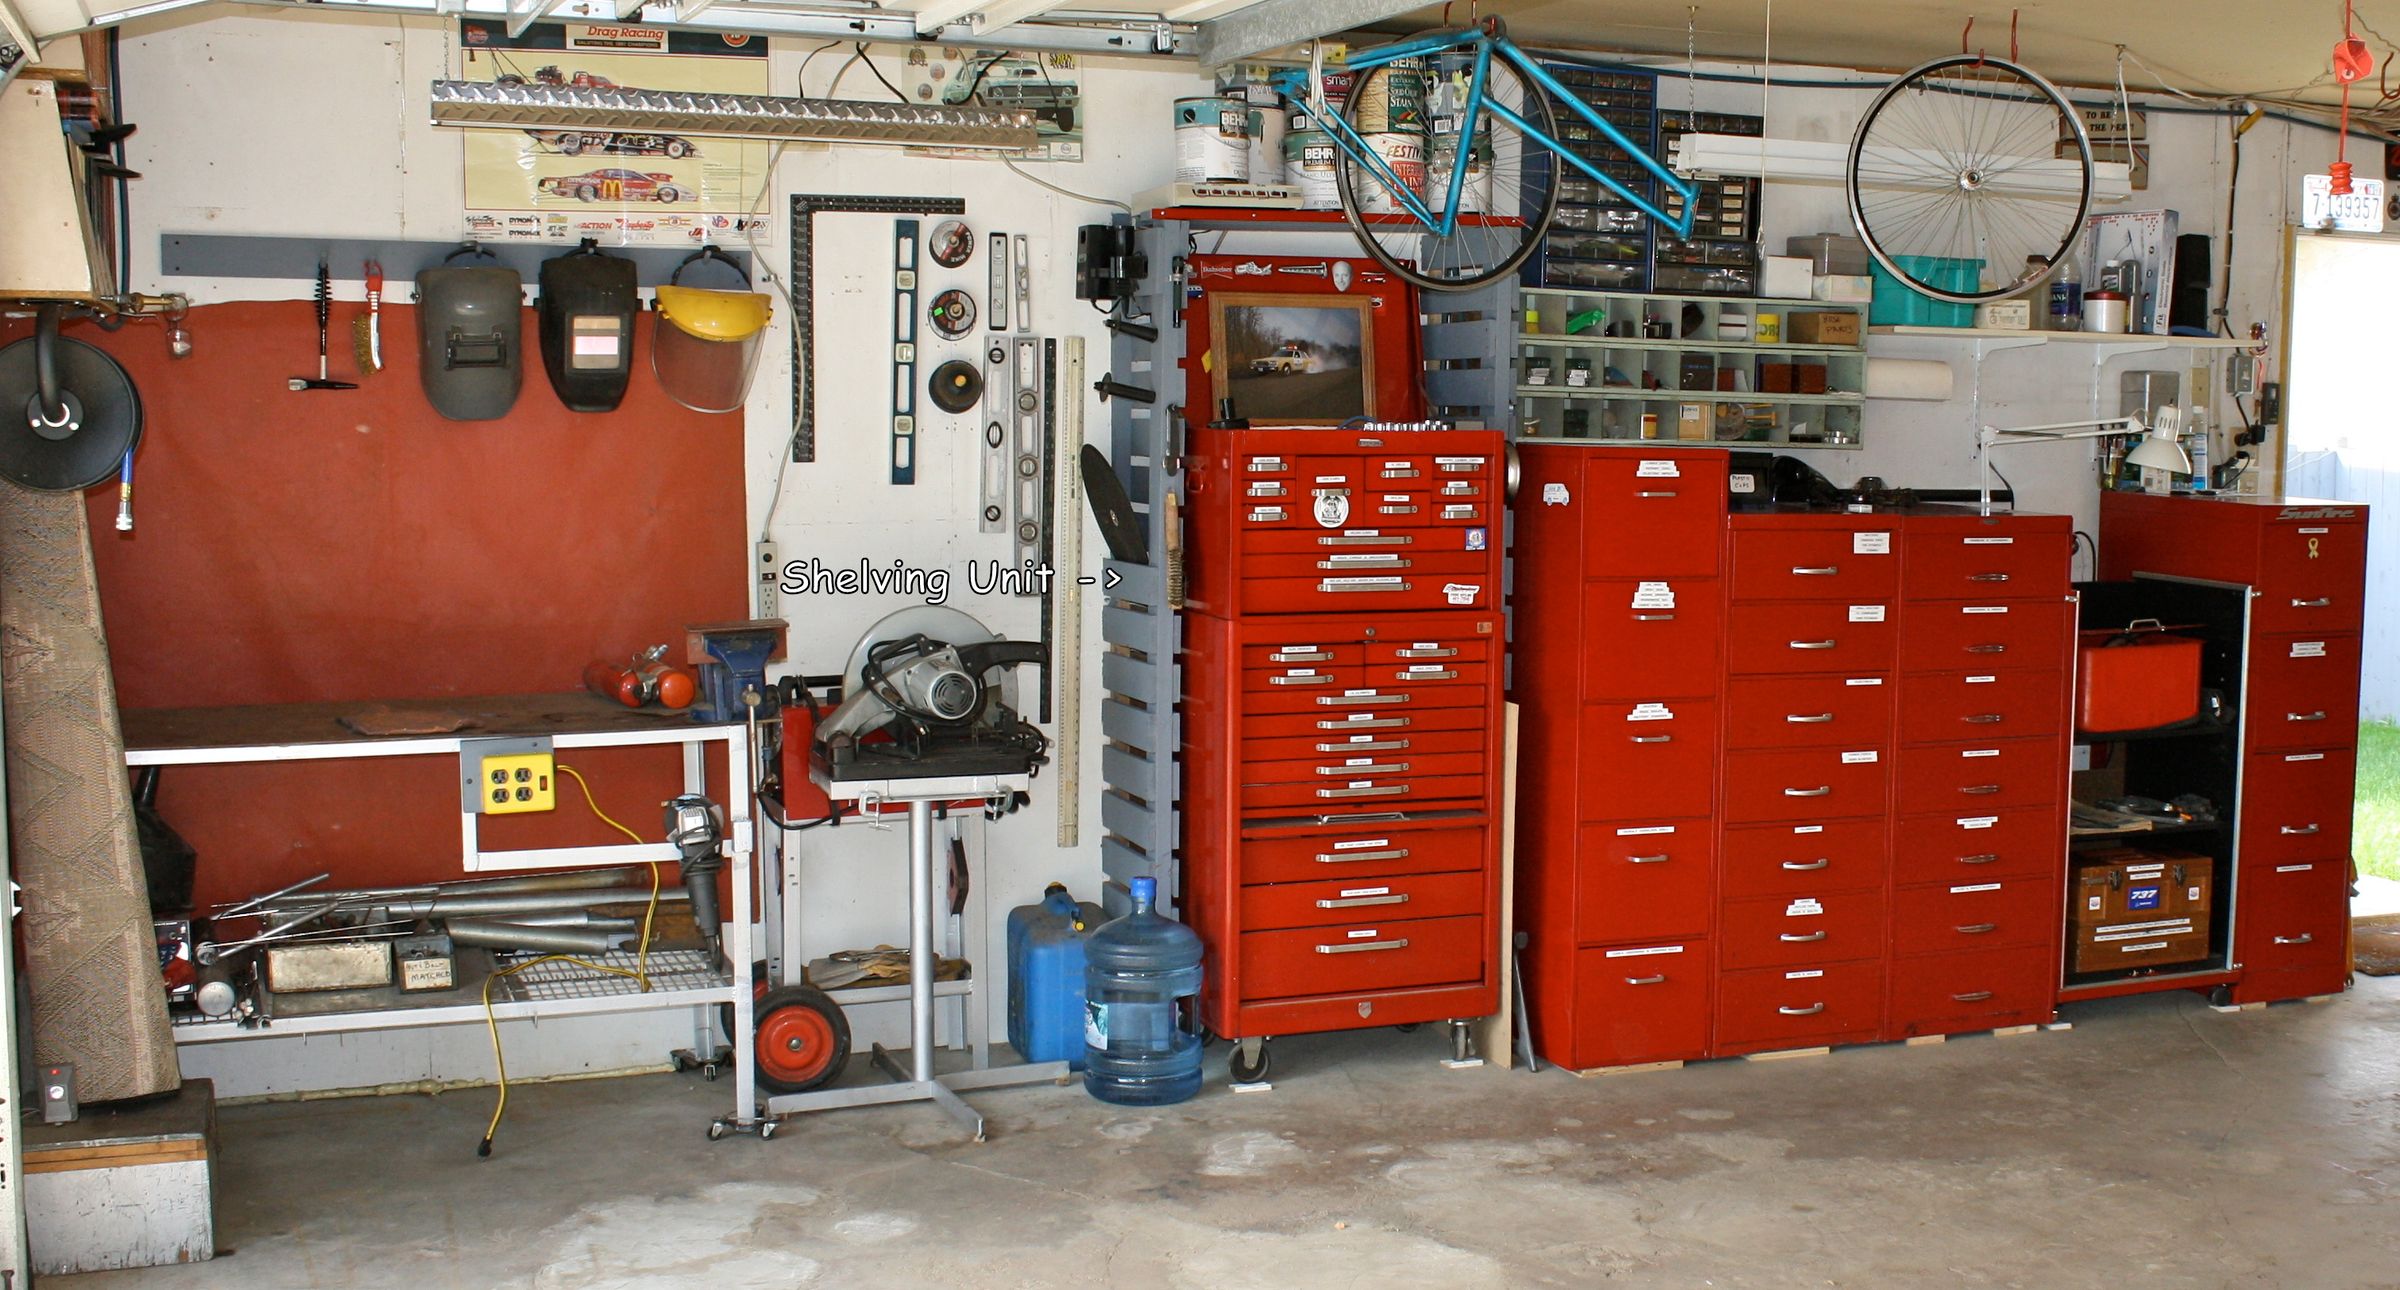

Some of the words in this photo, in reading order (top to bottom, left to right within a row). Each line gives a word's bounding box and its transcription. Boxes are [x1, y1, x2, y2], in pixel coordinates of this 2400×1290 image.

[587, 26, 618, 39] Drag
[620, 28, 665, 41] Racing
[2086, 111, 2097, 119] TO
[2101, 111, 2112, 119] BE
[2090, 123, 2107, 131] THE
[1304, 147, 1334, 160] BEHR
[2276, 507, 2356, 520] Sunfire
[2131, 889, 2158, 900] 737
